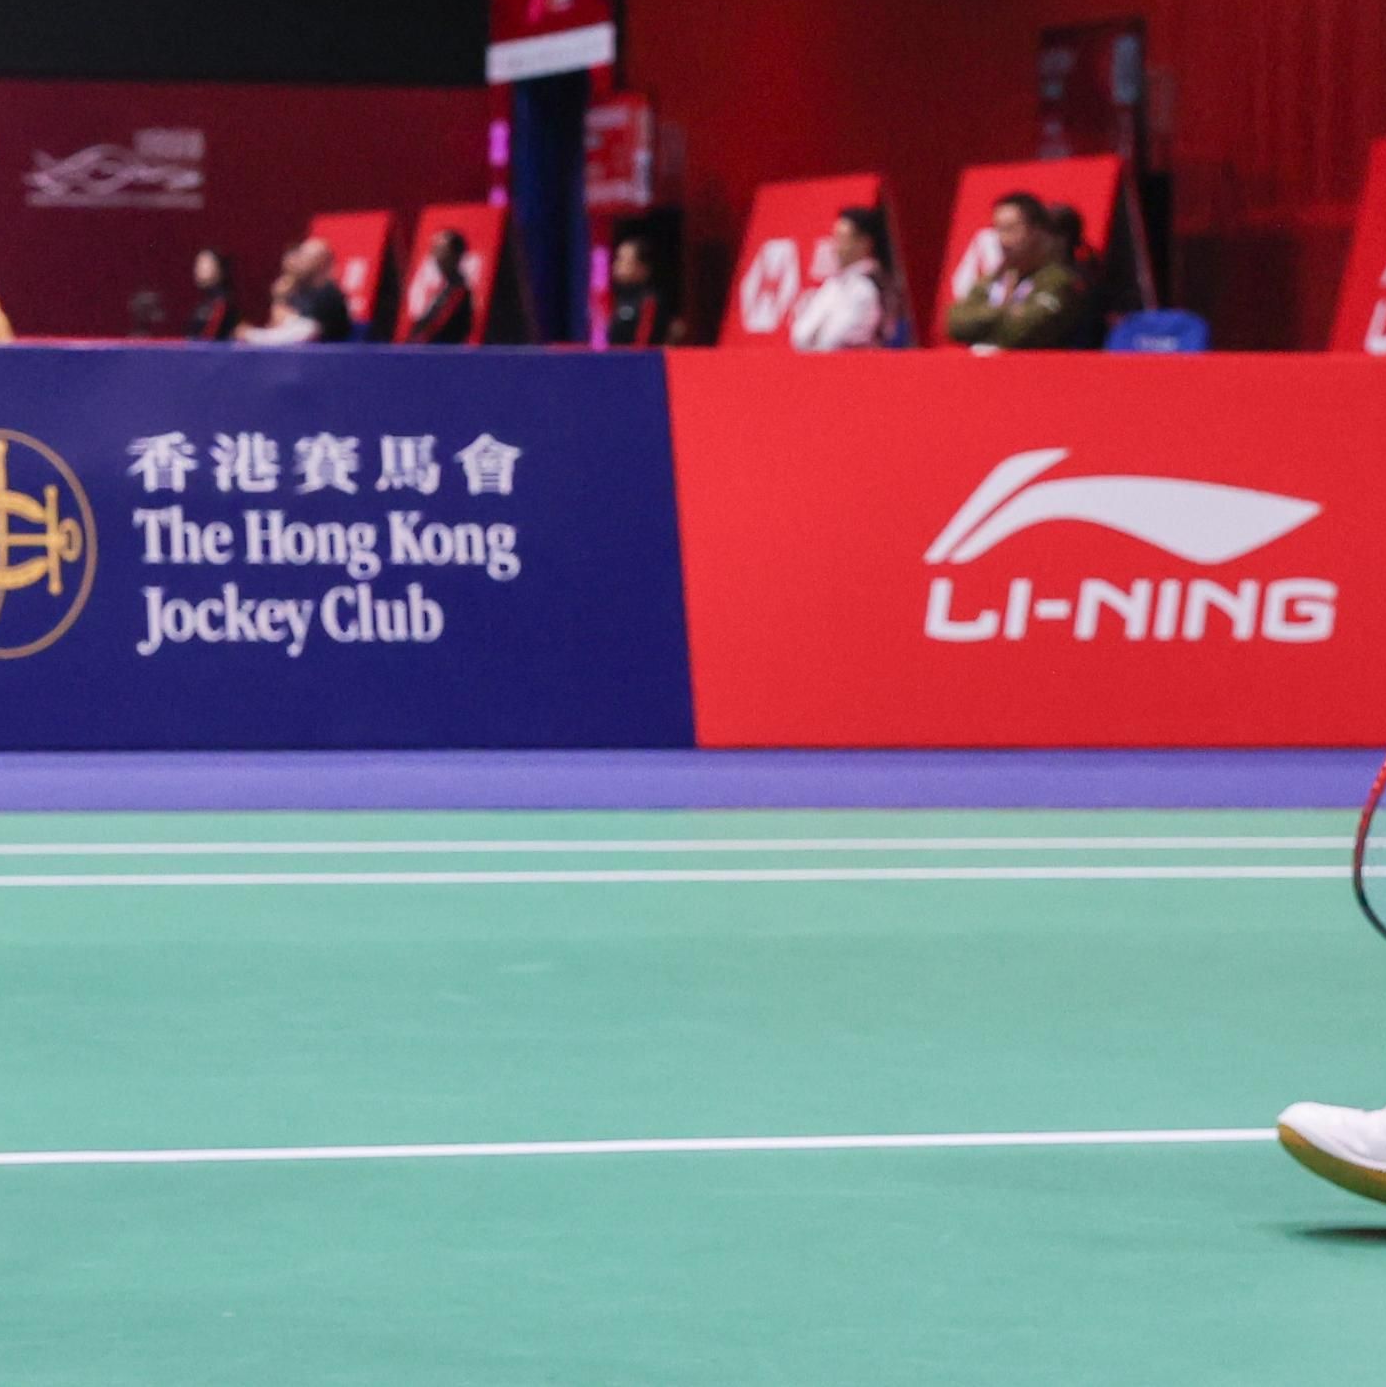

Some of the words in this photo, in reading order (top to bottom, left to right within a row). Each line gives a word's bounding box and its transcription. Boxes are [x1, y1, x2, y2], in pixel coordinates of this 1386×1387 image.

[126, 431, 522, 494] 香港賽馬會
[132, 506, 233, 565] The
[243, 508, 382, 580] Hong
[387, 509, 522, 581] Kong
[135, 581, 314, 657] Jockey
[320, 581, 444, 642] Club
[923, 577, 1338, 643] LI-NING
